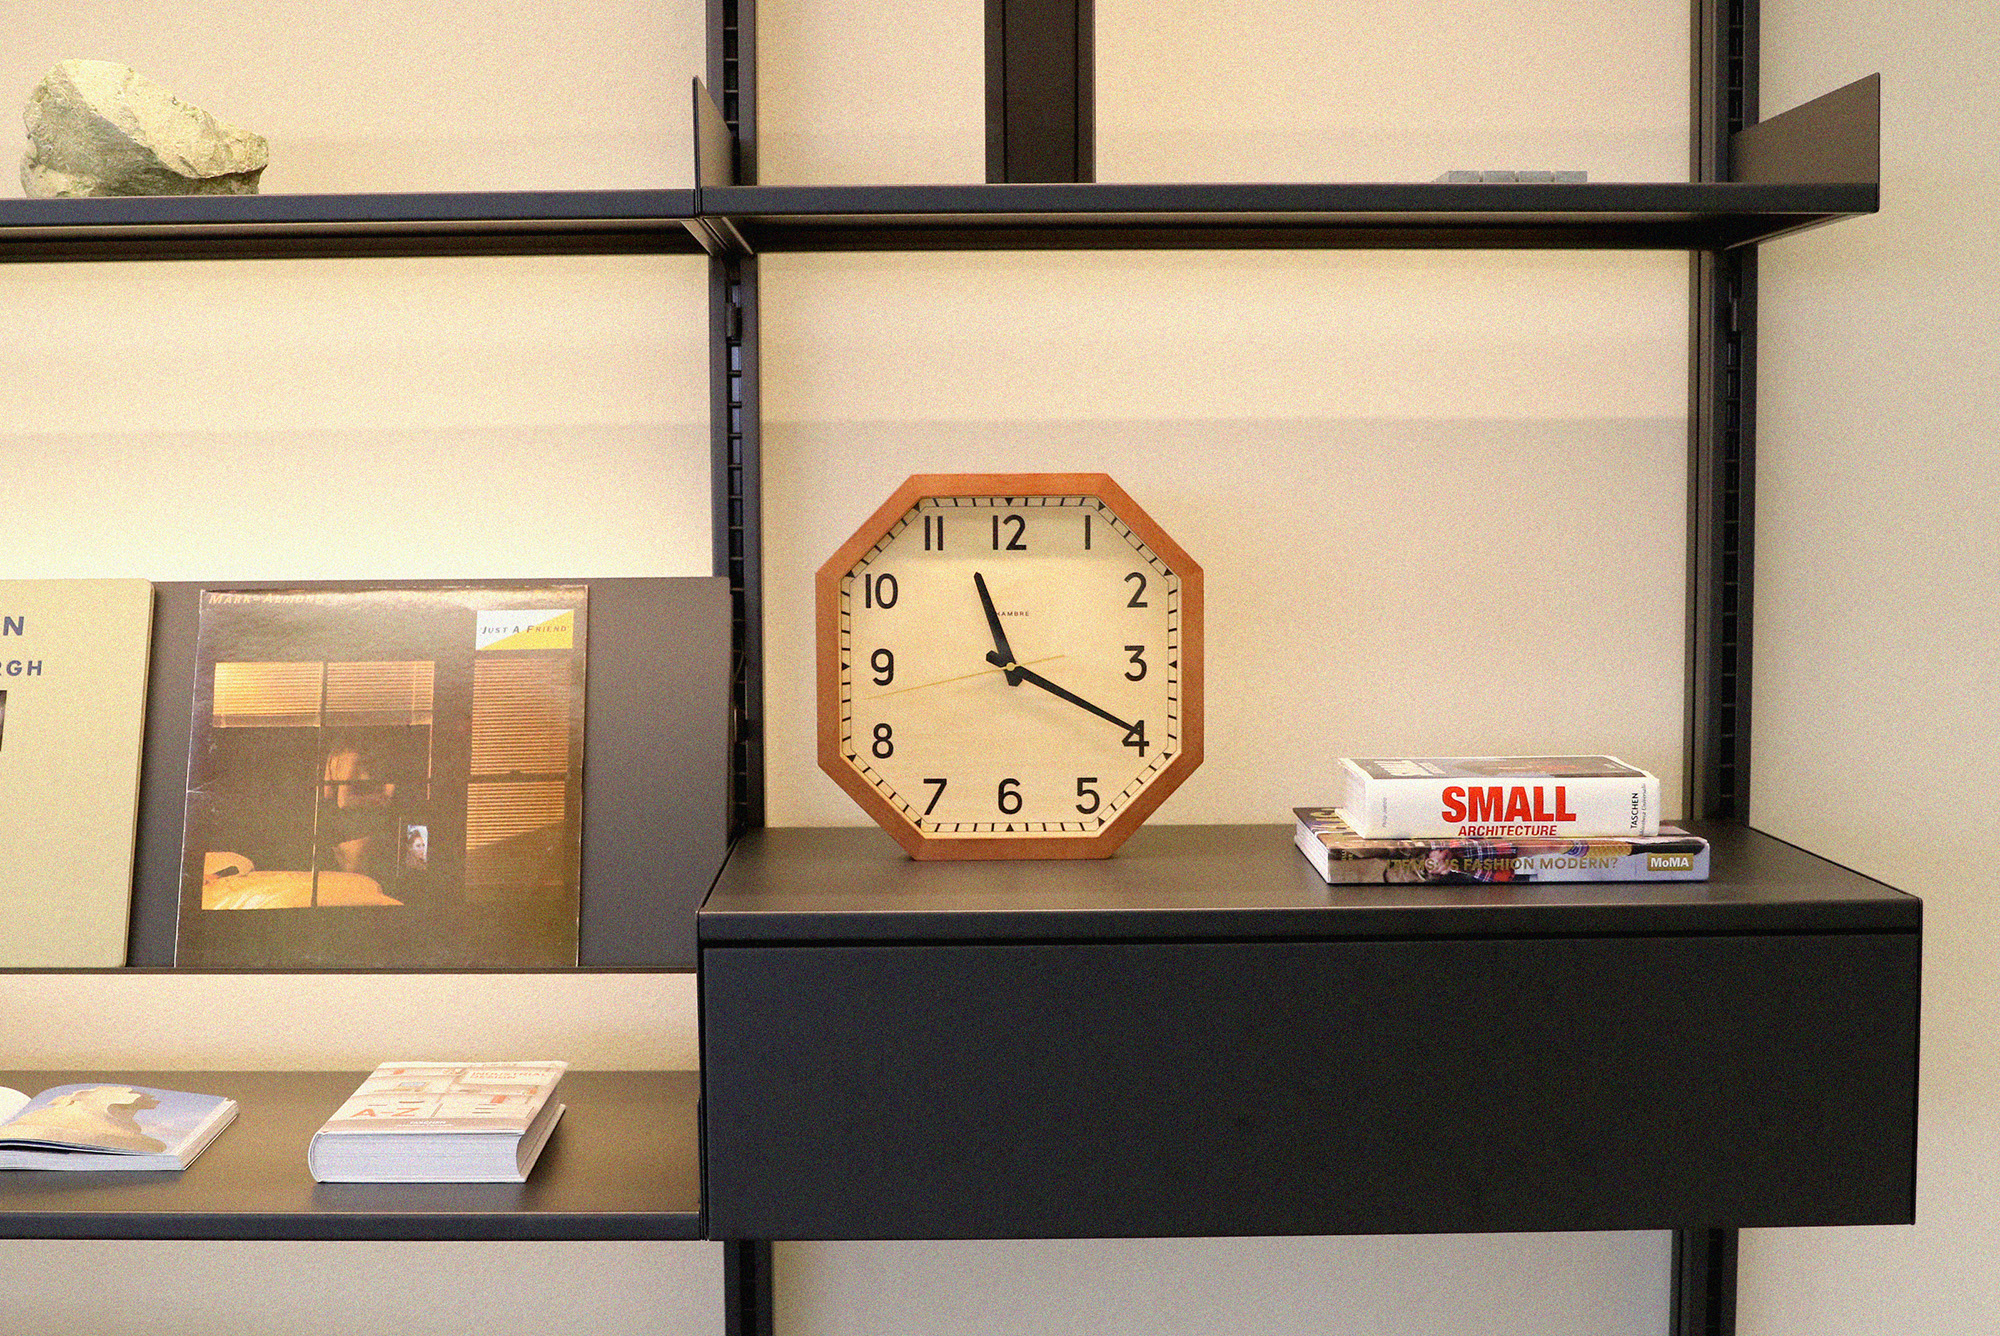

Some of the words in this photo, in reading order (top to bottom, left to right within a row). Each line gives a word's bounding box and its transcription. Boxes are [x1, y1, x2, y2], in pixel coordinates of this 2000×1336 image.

[924, 515, 944, 551] 11
[992, 514, 1028, 551] 12
[1084, 514, 1092, 550] 1
[864, 573, 899, 609] 10
[1124, 572, 1149, 608] 2
[512, 625, 520, 633] A
[0, 660, 42, 676] GH
[870, 648, 895, 686] 9
[1123, 645, 1148, 682] 3
[871, 723, 895, 759] 8
[1122, 720, 1150, 757] 4
[923, 778, 947, 815] 7
[997, 777, 1023, 815] 6
[1075, 777, 1101, 815] 5
[1441, 785, 1577, 823] SMALL
[1630, 792, 1639, 829] TASCHEN
[1458, 825, 1558, 837] ARCHITECTURE
[1463, 857, 1534, 871] FASHION
[1539, 857, 1619, 870] MODERN?
[1650, 857, 1690, 868] MoMA
[349, 1107, 421, 1118] A-Z
